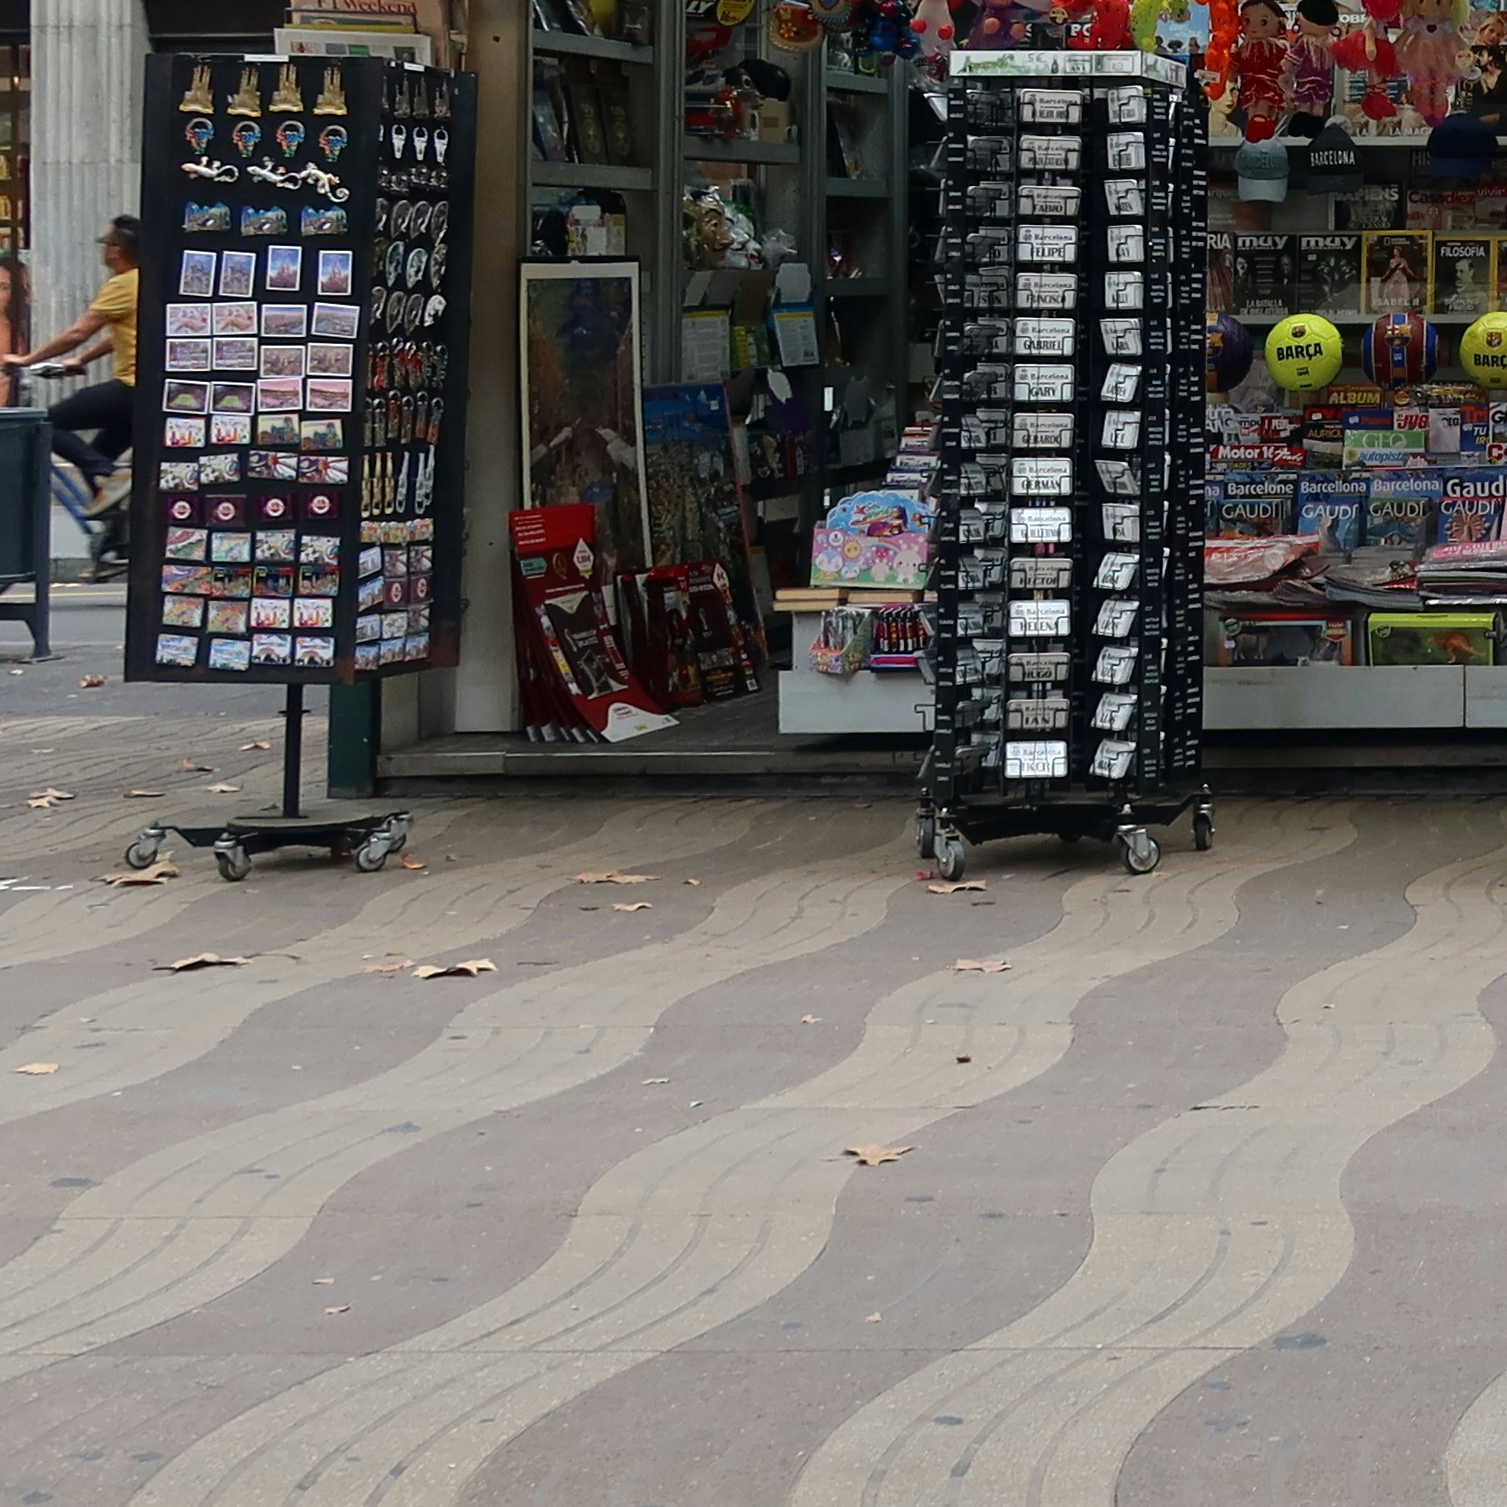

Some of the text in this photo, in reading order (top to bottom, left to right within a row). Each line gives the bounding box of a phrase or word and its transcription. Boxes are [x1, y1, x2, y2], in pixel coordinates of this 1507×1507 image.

[1310, 150, 1356, 168] BARCELONA
[1237, 234, 1289, 250] muy
[1301, 234, 1358, 250] muy
[1276, 342, 1324, 361] BARÇA
[1328, 392, 1380, 404] ALBUM
[1228, 481, 1294, 495] Barcelone
[1301, 480, 1367, 494] Barcellona
[1373, 479, 1439, 493] Barcelona
